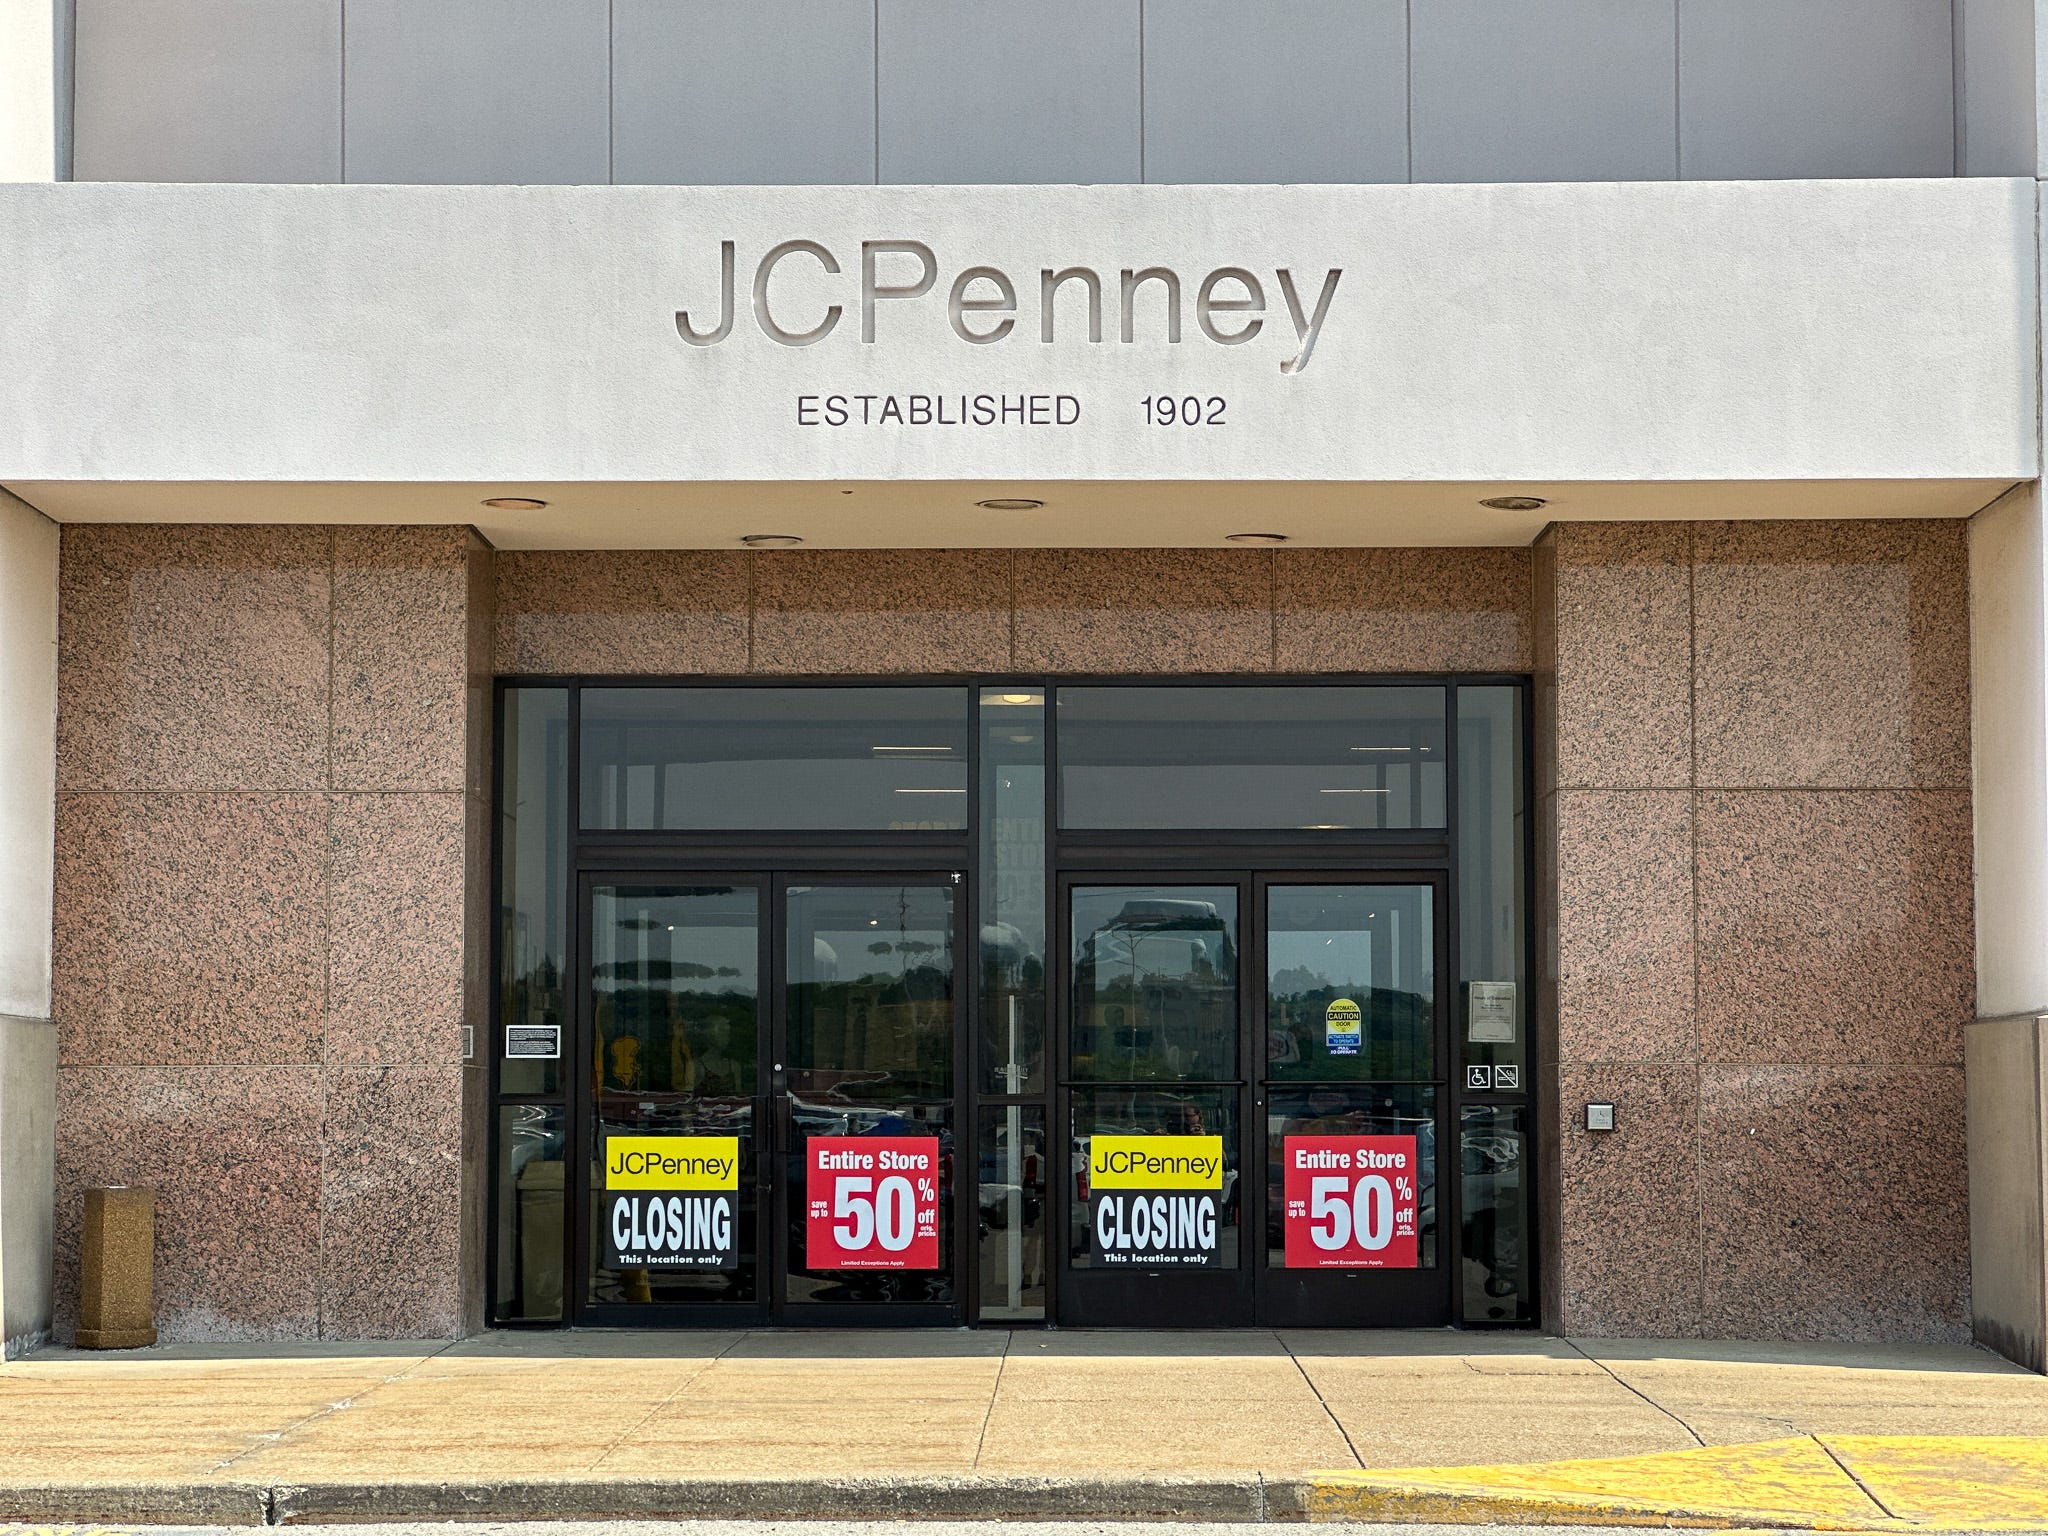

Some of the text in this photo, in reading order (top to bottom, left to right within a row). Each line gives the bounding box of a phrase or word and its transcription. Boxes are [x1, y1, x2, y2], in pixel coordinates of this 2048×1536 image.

[675, 239, 1343, 375] JCPenney
[797, 395, 1228, 427] ESTABLISHED 1902
[610, 1152, 734, 1181] JCPenney
[818, 1150, 929, 1170] Entire Store
[1095, 1151, 1219, 1180] JCPenney
[1295, 1149, 1406, 1169] Entire Store
[810, 1208, 828, 1219] up to
[811, 1200, 828, 1209] save
[1288, 1200, 1305, 1209] save
[1288, 1208, 1306, 1219] up to
[612, 1196, 731, 1251] CLOSING
[917, 1208, 935, 1224] off
[1097, 1195, 1216, 1250] CLOSING
[1395, 1207, 1413, 1223] off
[619, 1254, 723, 1266] This location only
[1103, 1253, 1208, 1265] This location only
